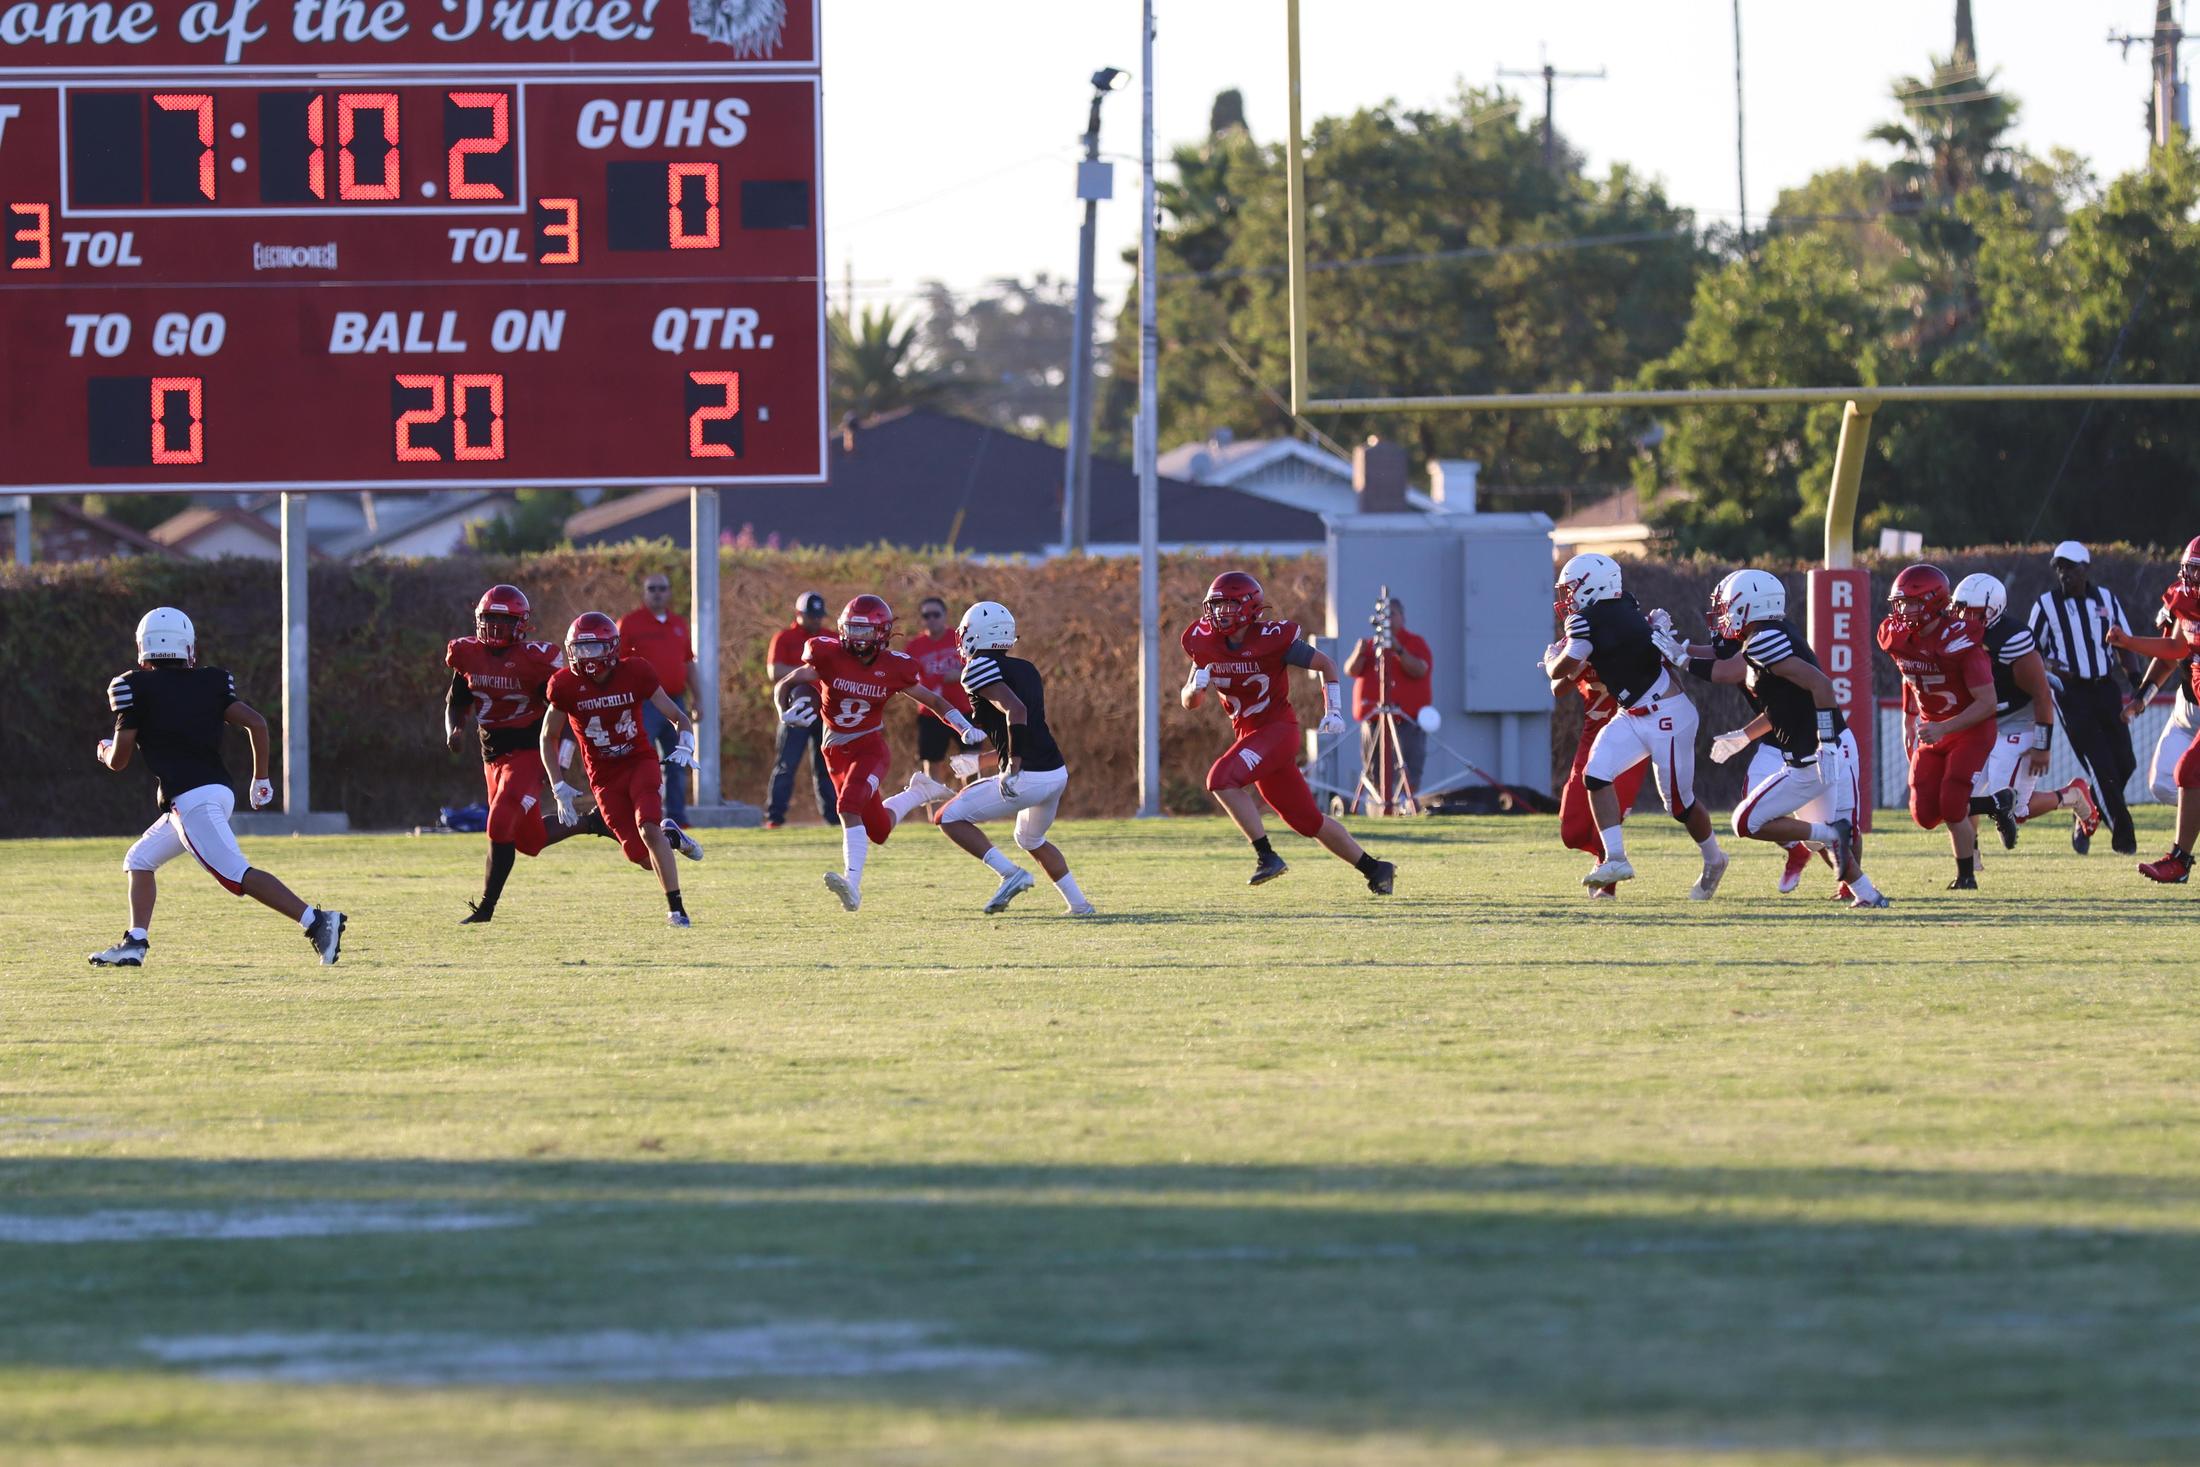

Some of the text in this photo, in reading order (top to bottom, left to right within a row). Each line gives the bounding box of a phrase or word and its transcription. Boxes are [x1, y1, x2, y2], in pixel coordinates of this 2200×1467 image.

[179, 0, 267, 63] of
[293, 0, 409, 42] the
[576, 98, 751, 149] CUHS
[668, 162, 720, 249] 0
[10, 202, 143, 270] 3 TOL
[447, 198, 579, 264] TOL 3
[65, 312, 226, 357] TO GO
[329, 309, 566, 354] BALL ON
[651, 307, 774, 355] QTR.
[151, 377, 203, 464] 0
[396, 373, 505, 461] 20
[689, 371, 740, 457] 2
[1831, 581, 1853, 722] REDS
[471, 673, 522, 690] HOWCHILLA
[833, 678, 887, 697] CHOWCHILLA
[1210, 673, 1270, 720] 52
[471, 690, 534, 725] 22
[585, 709, 638, 746] 44
[833, 698, 871, 728] 8
[1659, 717, 1672, 730] G
[2007, 732, 2021, 744] G
